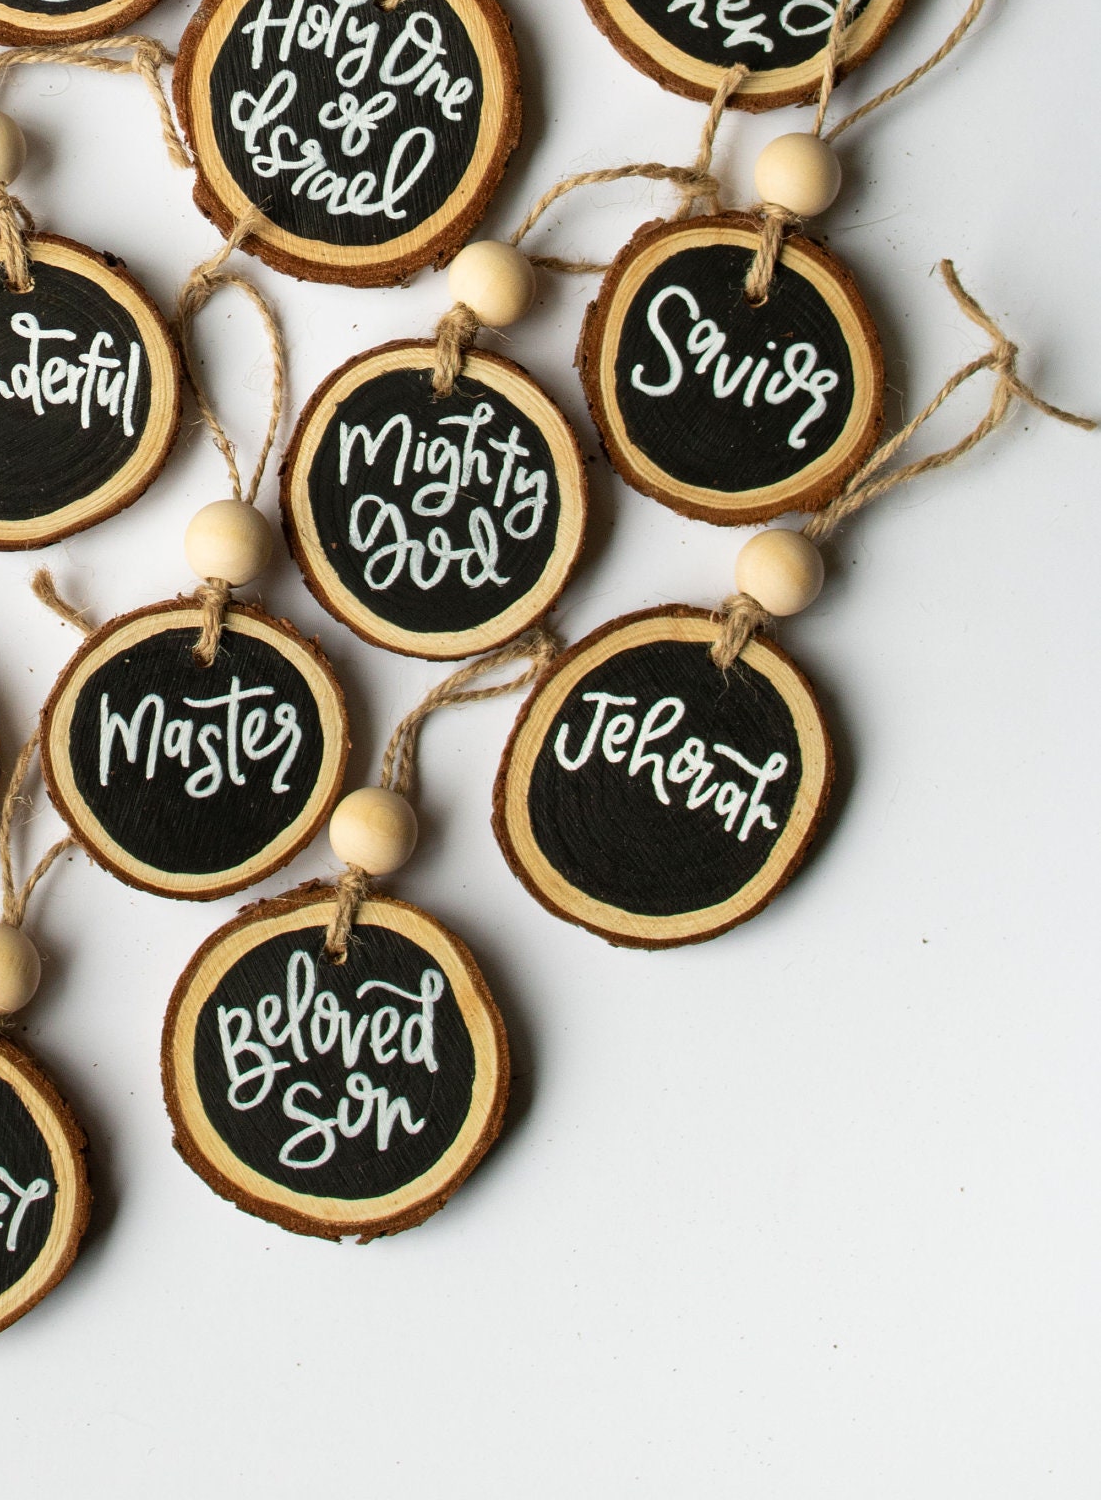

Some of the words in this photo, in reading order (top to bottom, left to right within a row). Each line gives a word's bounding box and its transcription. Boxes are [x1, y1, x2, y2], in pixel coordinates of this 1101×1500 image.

[317, 90, 397, 157] of
[378, 10, 474, 122] One
[229, 69, 436, 220] Israel
[630, 285, 839, 450] Savior
[339, 402, 549, 540] Mighty
[348, 494, 511, 591] God
[98, 675, 302, 799] Master
[553, 691, 789, 842] Jehovah
[216, 950, 445, 1111] Beloved
[278, 1072, 427, 1170] Son
